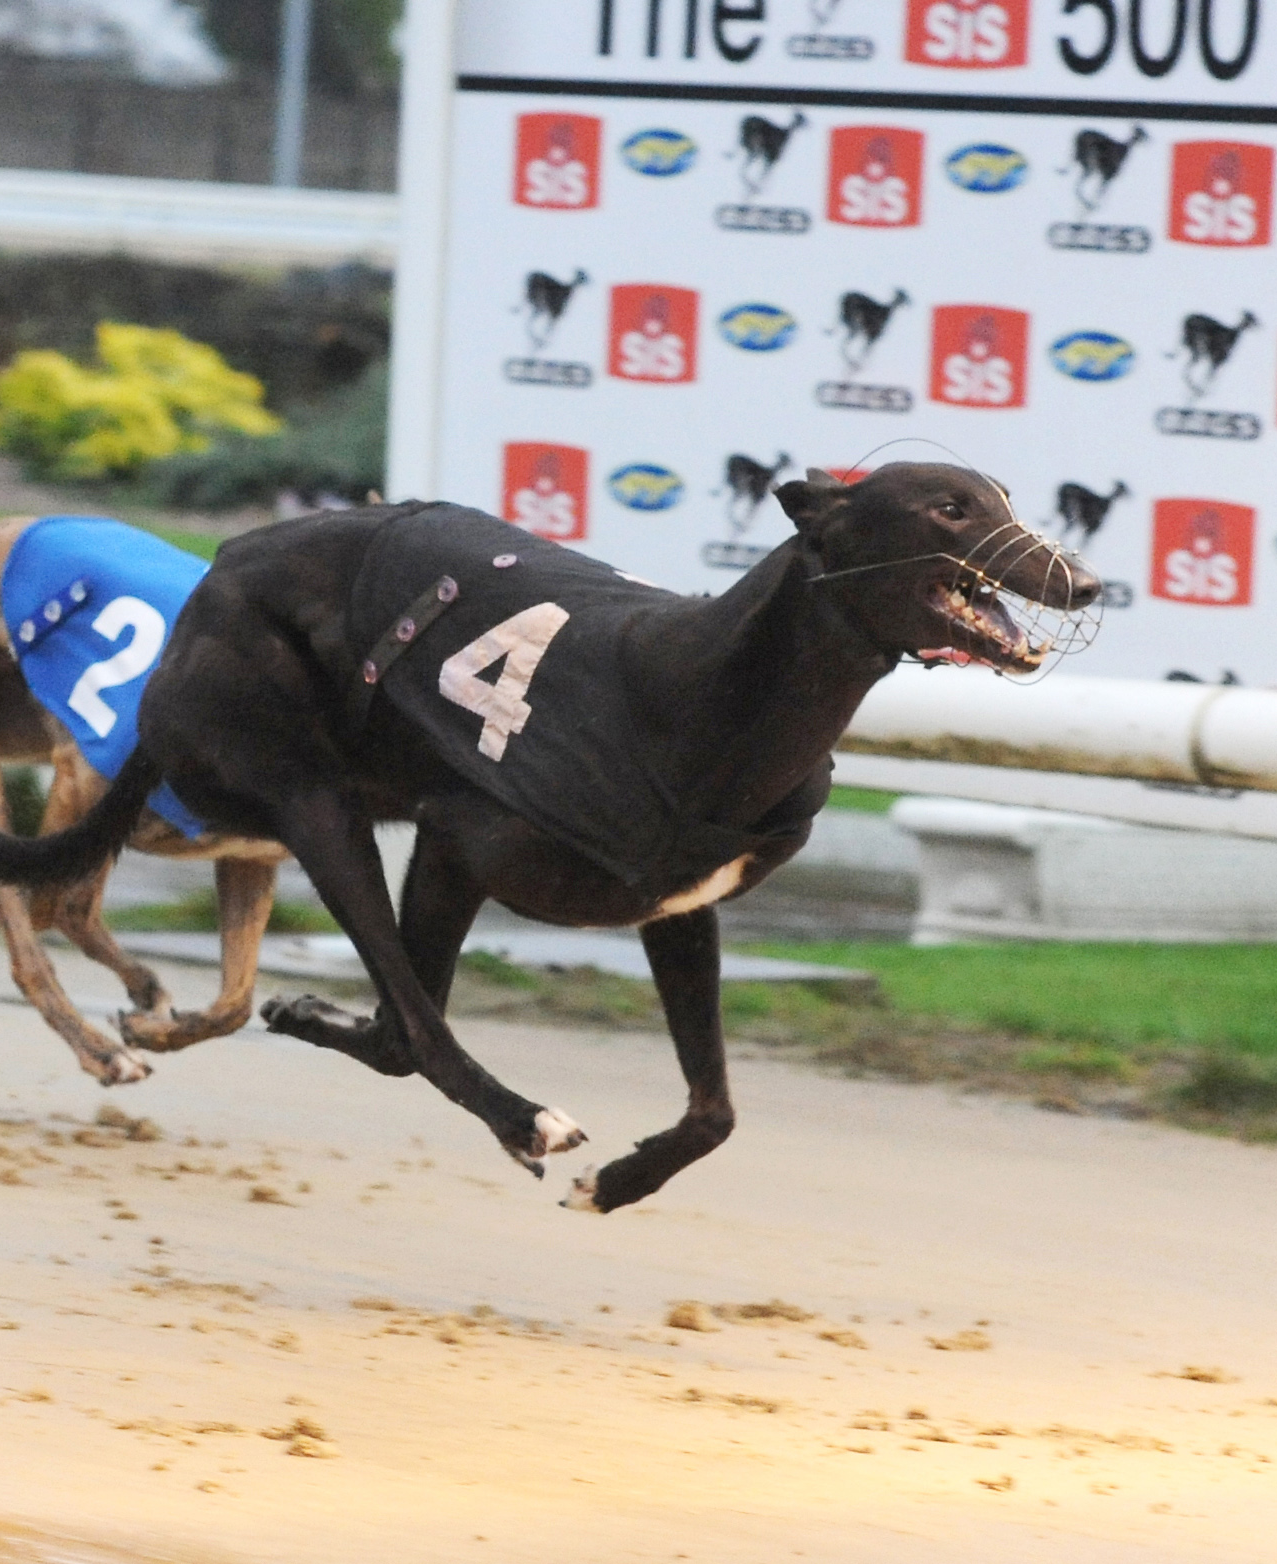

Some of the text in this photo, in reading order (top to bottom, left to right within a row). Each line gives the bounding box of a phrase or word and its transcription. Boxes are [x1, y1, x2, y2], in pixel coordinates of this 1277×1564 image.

[1058, 0, 1260, 80] 500
[67, 595, 167, 738] 2
[438, 601, 570, 762] 4
